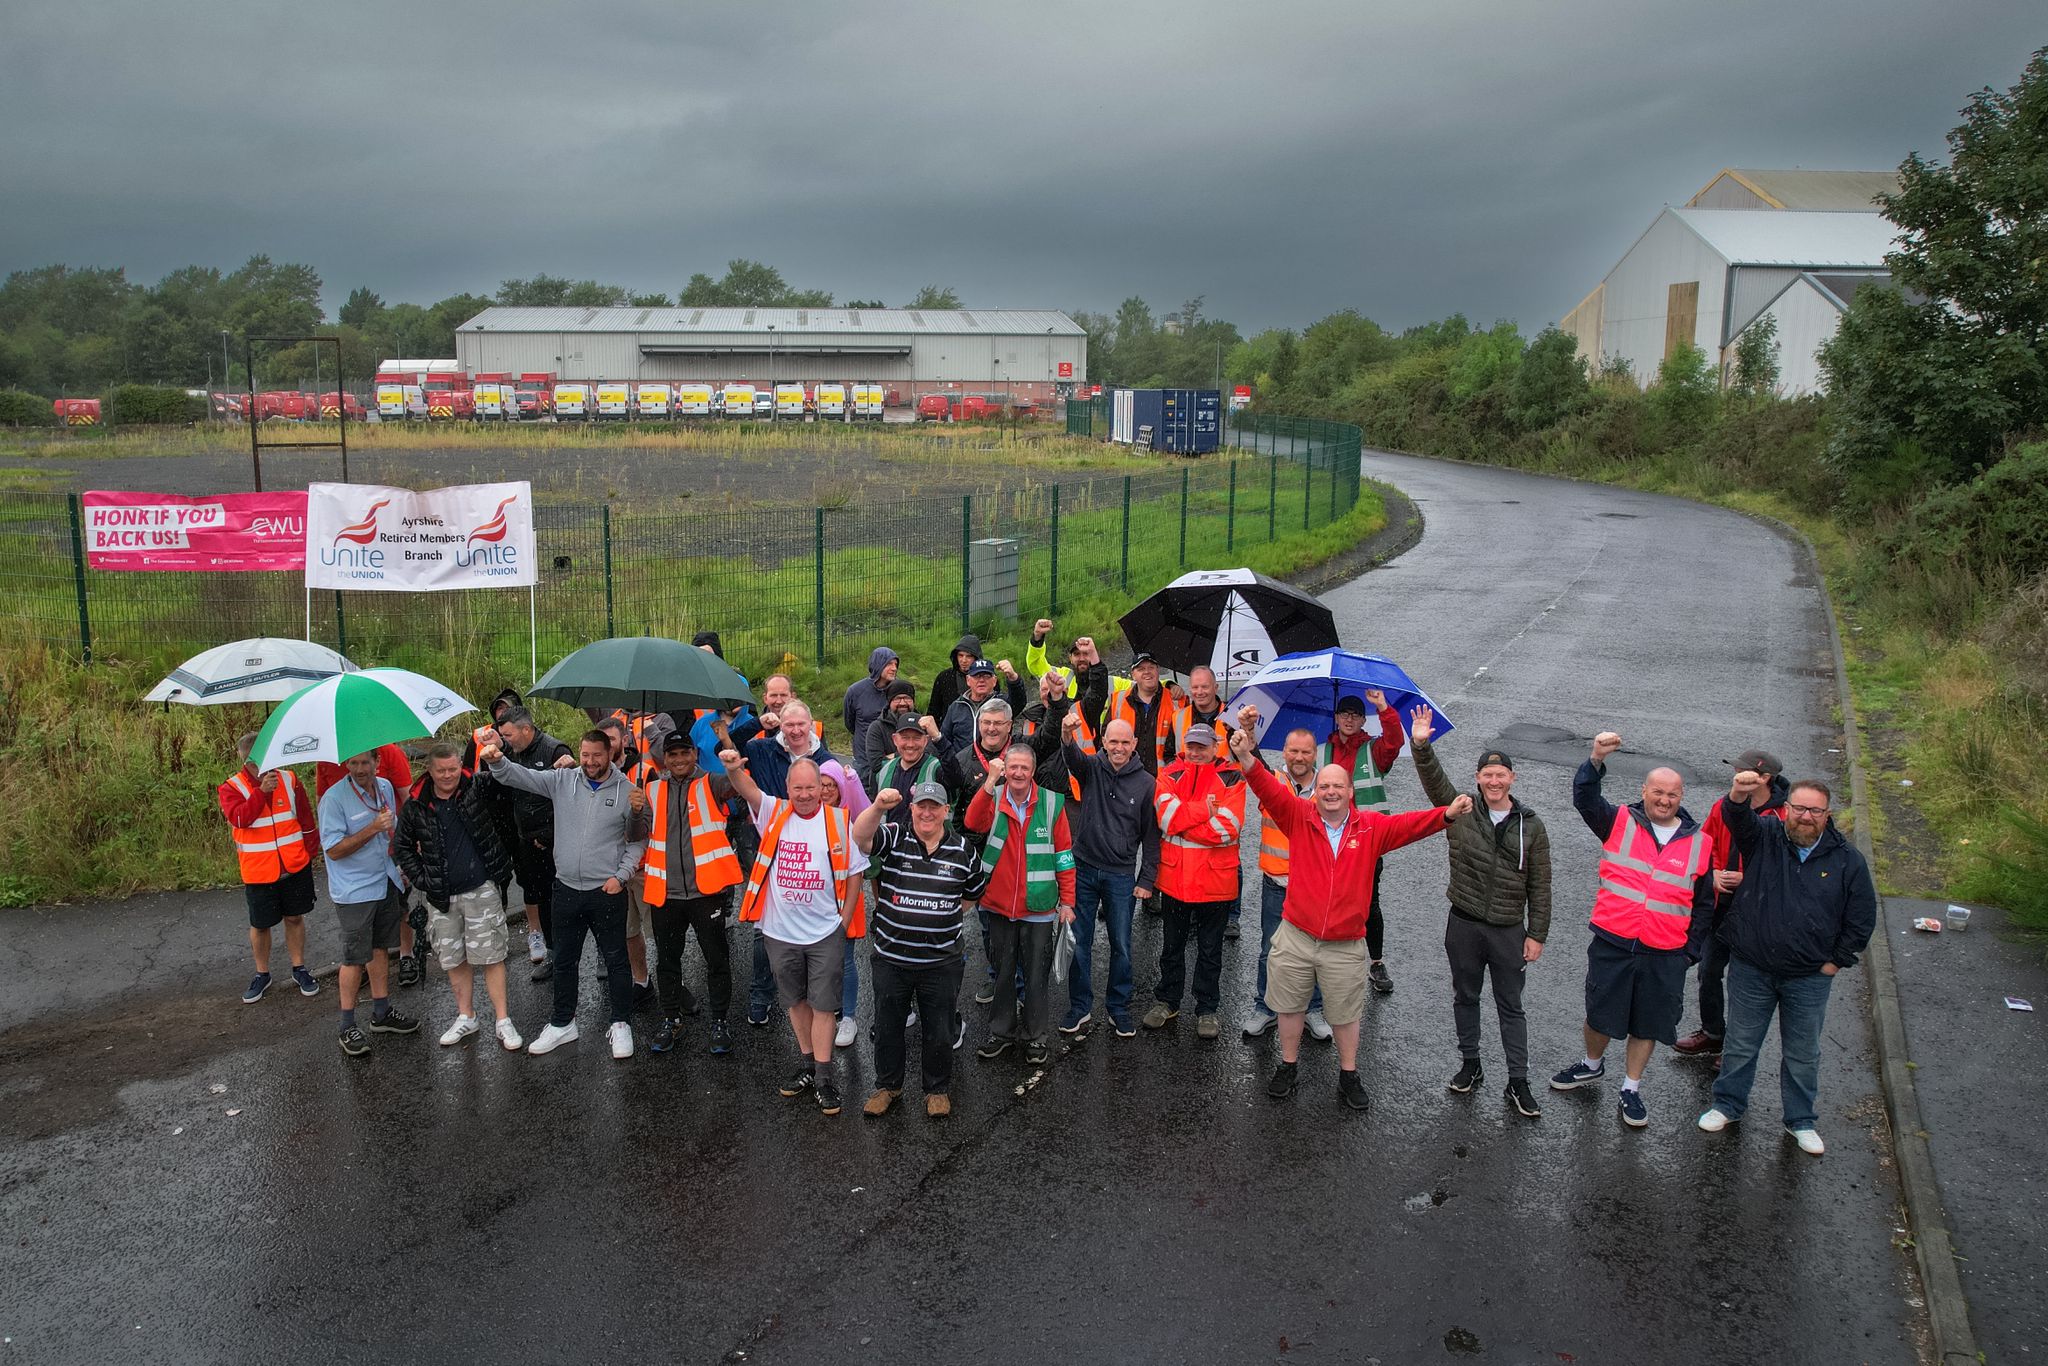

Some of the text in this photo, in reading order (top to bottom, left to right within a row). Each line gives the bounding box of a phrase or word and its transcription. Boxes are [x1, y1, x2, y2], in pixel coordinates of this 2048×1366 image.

[93, 507, 217, 526] HONK IF YOU
[401, 516, 444, 529] Ayrshire
[251, 516, 303, 537] CWU
[96, 530, 180, 547] BACK US!
[380, 532, 466, 543] Retired Members
[321, 546, 385, 568] unite
[405, 550, 443, 561] Branch
[456, 543, 517, 568] unite
[975, 660, 988, 668] NY
[214, 679, 247, 691] LAMBERT
[253, 671, 280, 682] BUTLER
[780, 841, 806, 852] THIS IS
[779, 850, 809, 862] WHAT A
[779, 859, 804, 870] TRADE
[778, 868, 818, 880] UNIONIST
[778, 877, 824, 889] LOOKS LIKE
[784, 890, 813, 904] CWU
[899, 895, 955, 910] Morning Star
